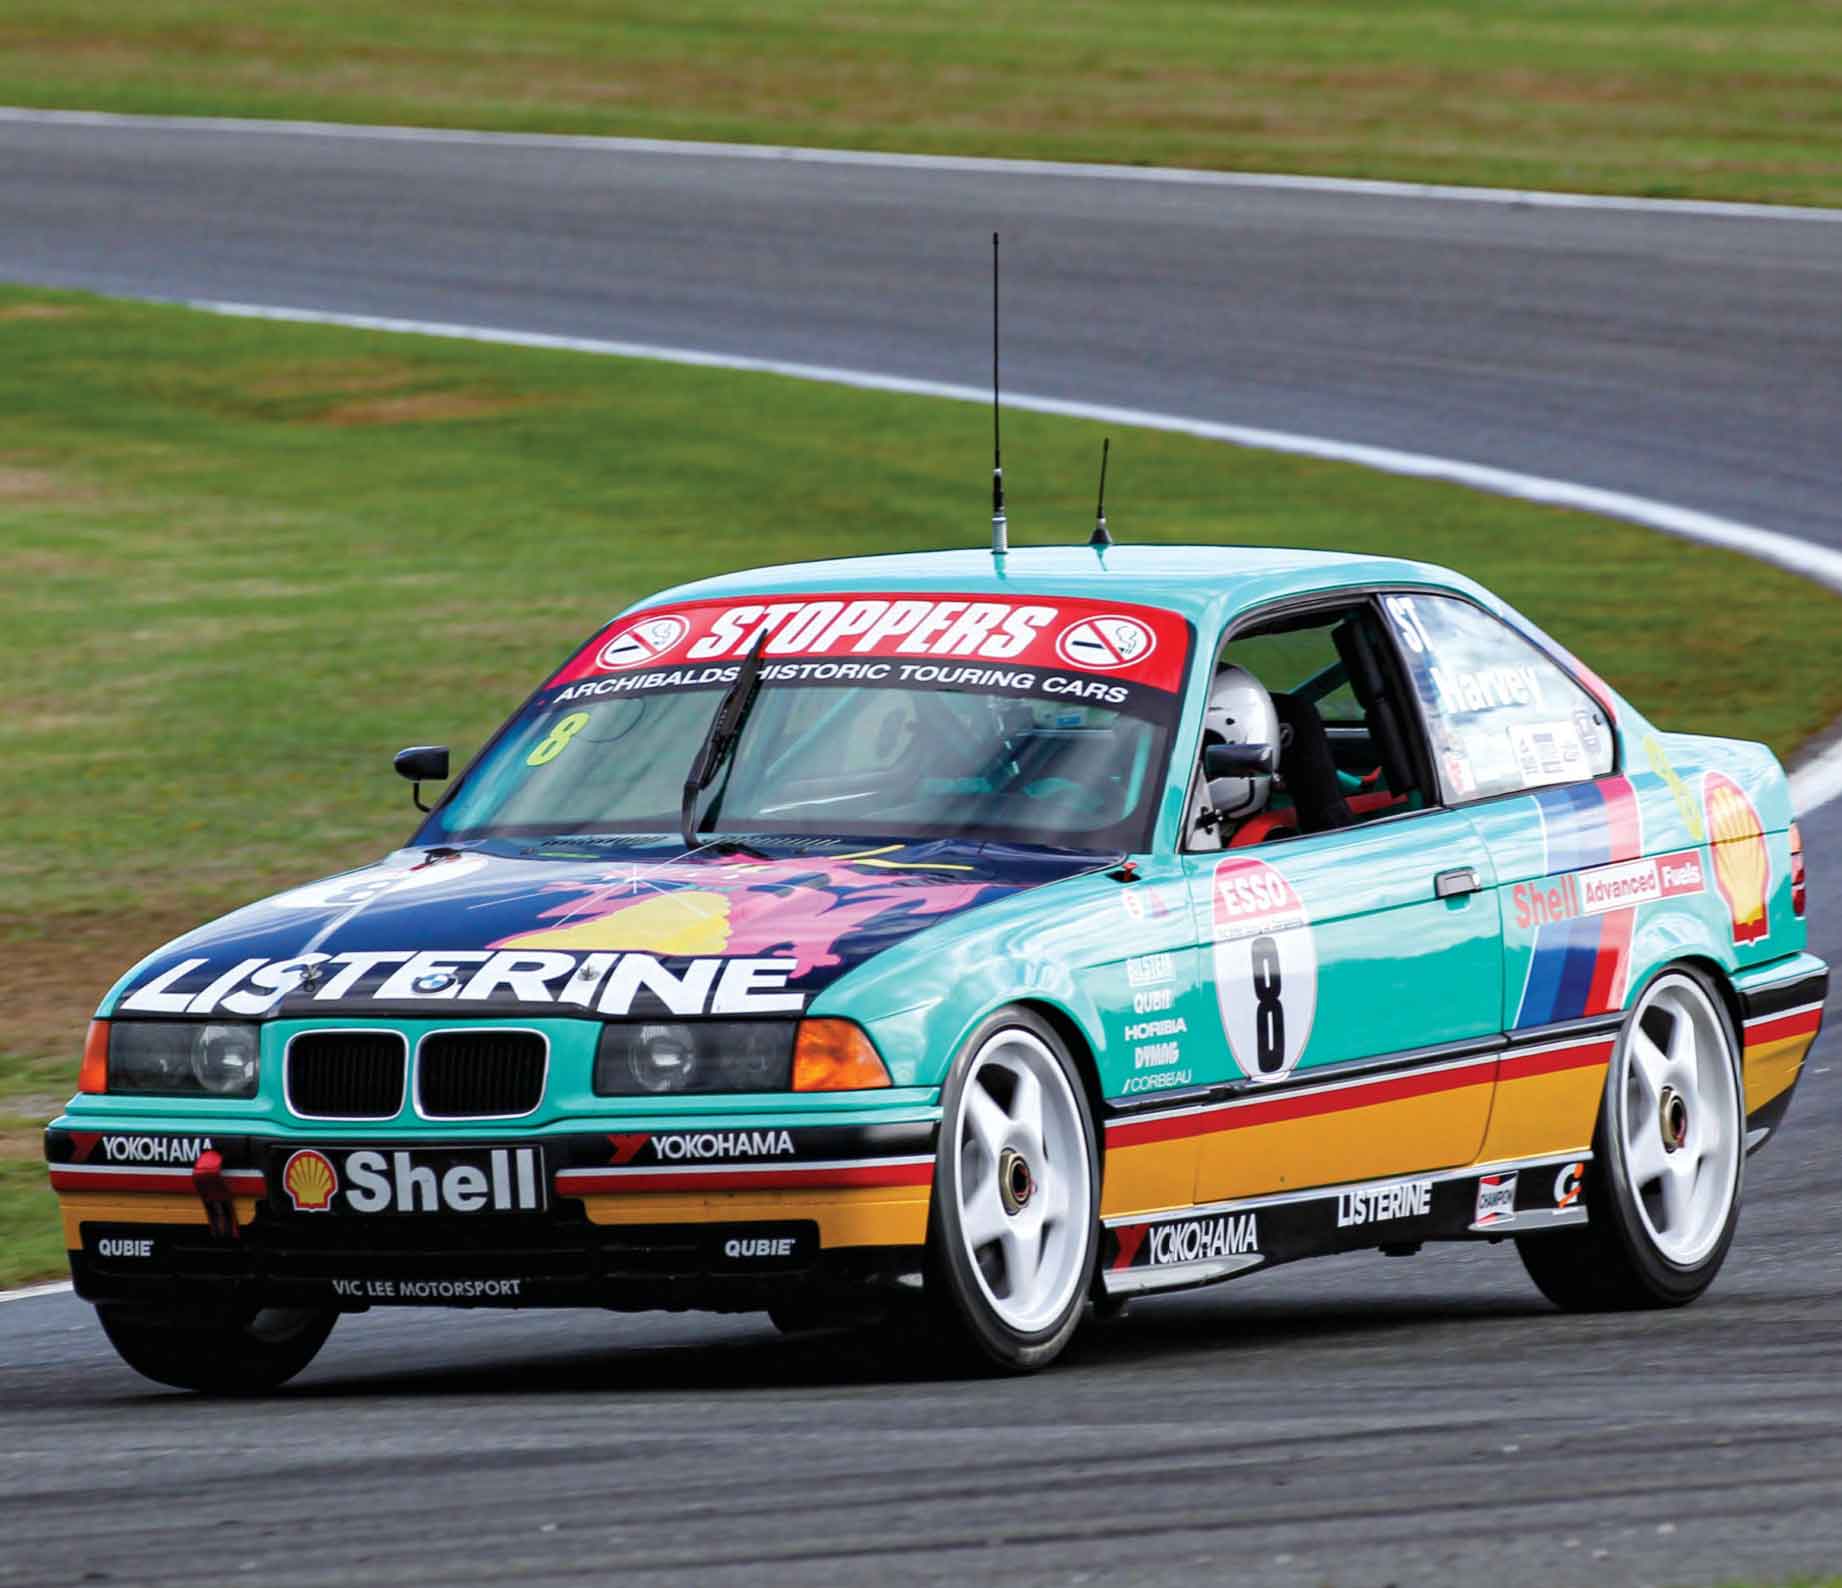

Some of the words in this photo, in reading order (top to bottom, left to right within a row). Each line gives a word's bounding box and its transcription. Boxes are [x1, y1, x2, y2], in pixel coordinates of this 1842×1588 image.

[686, 600, 1059, 659] STOPPERS
[553, 666, 741, 704] ARCHIBALDS
[900, 665, 1035, 689] TOURING
[1042, 676, 1129, 703] CARS
[526, 711, 591, 767] 8
[1221, 871, 1289, 916] ESSO
[1512, 874, 1580, 929] Shell
[1586, 872, 1657, 904] Advanced
[120, 950, 805, 1016] LISTERINE
[1251, 936, 1287, 1074] 8
[651, 1130, 795, 1160] YOKOHAMA
[345, 1148, 536, 1213] Shell
[1337, 1182, 1433, 1228] LISTERINE
[99, 1239, 152, 1257] QUBIE
[725, 1239, 793, 1258] QUBIE
[1149, 1213, 1258, 1265] YOKOHAMA
[333, 1280, 363, 1296] VIC
[366, 1281, 396, 1297] LEE
[400, 1280, 521, 1297] MOTORSPORT
